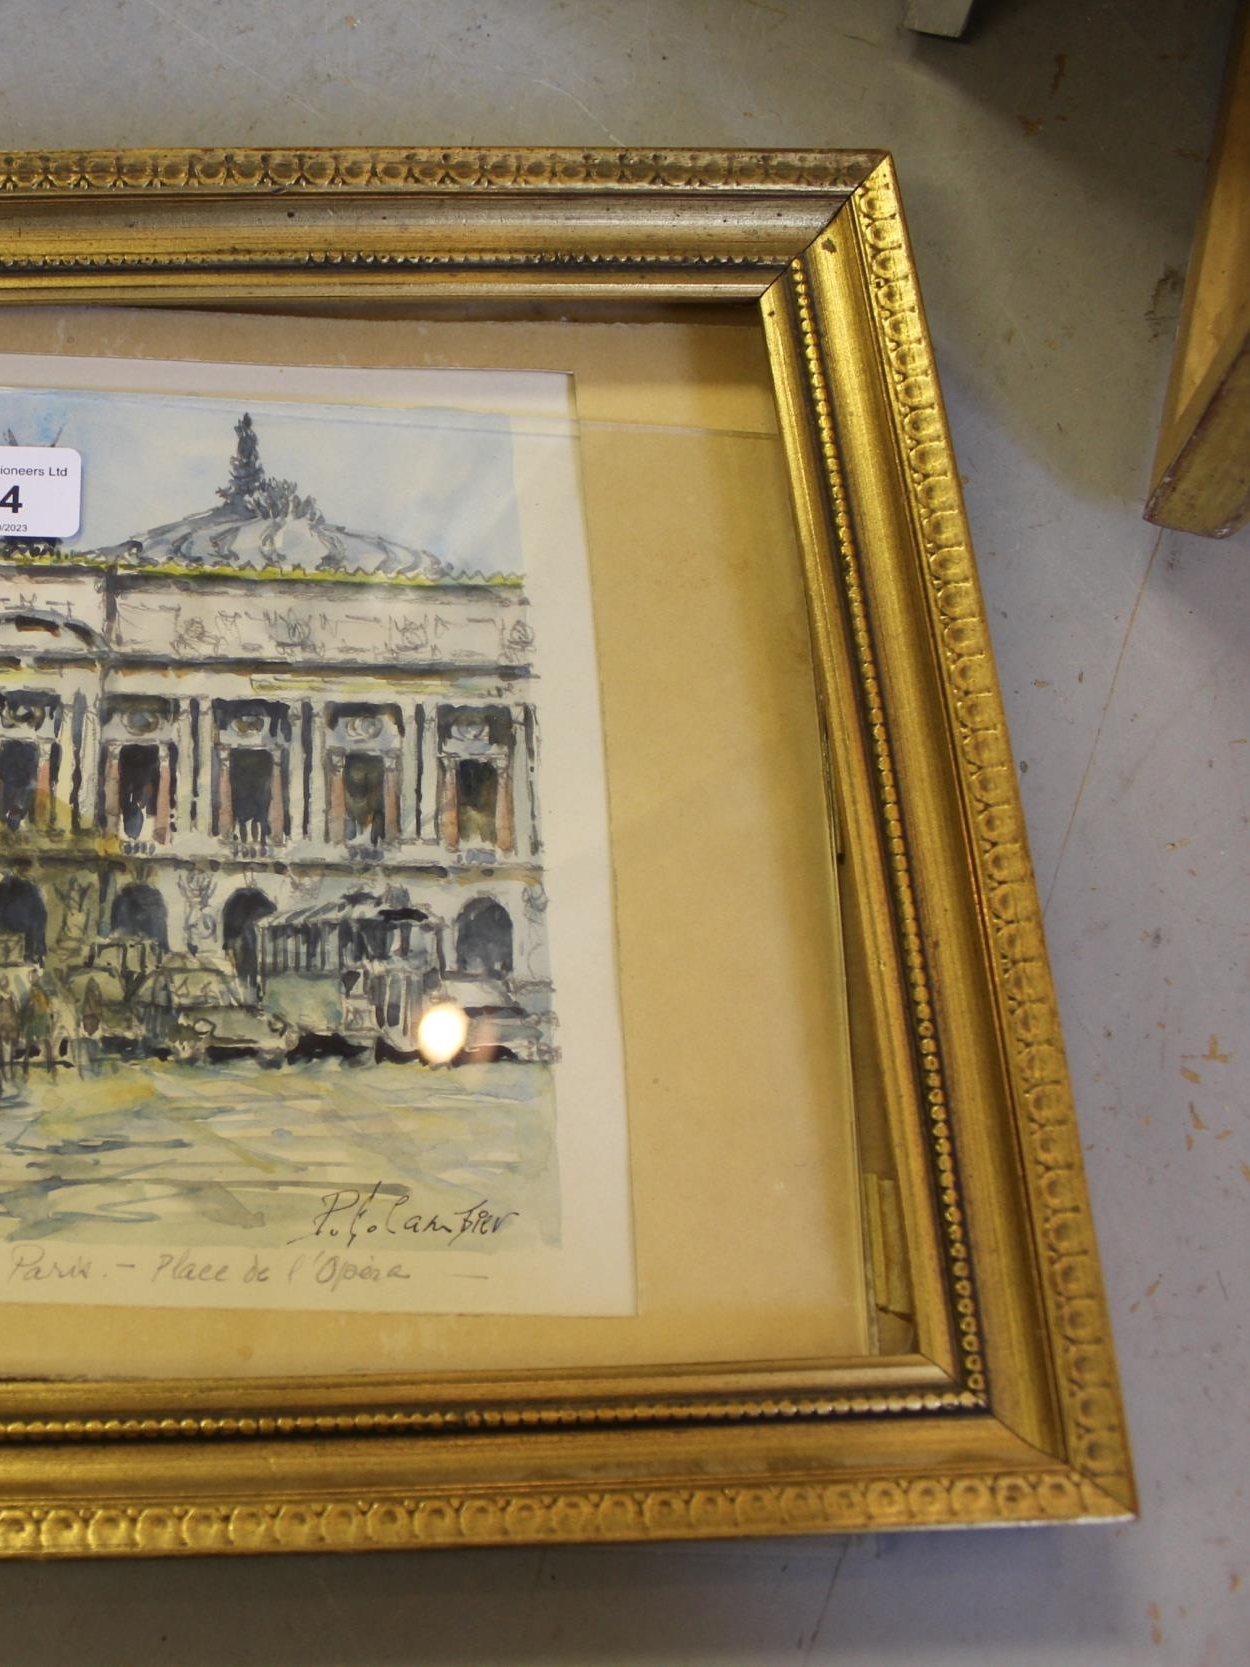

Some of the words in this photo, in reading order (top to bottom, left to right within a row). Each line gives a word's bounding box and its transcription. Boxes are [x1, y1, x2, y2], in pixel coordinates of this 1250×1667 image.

[49, 467, 68, 477] Ltd
[151, 1248, 230, 1284] Place
[243, 1254, 270, 1284] de
